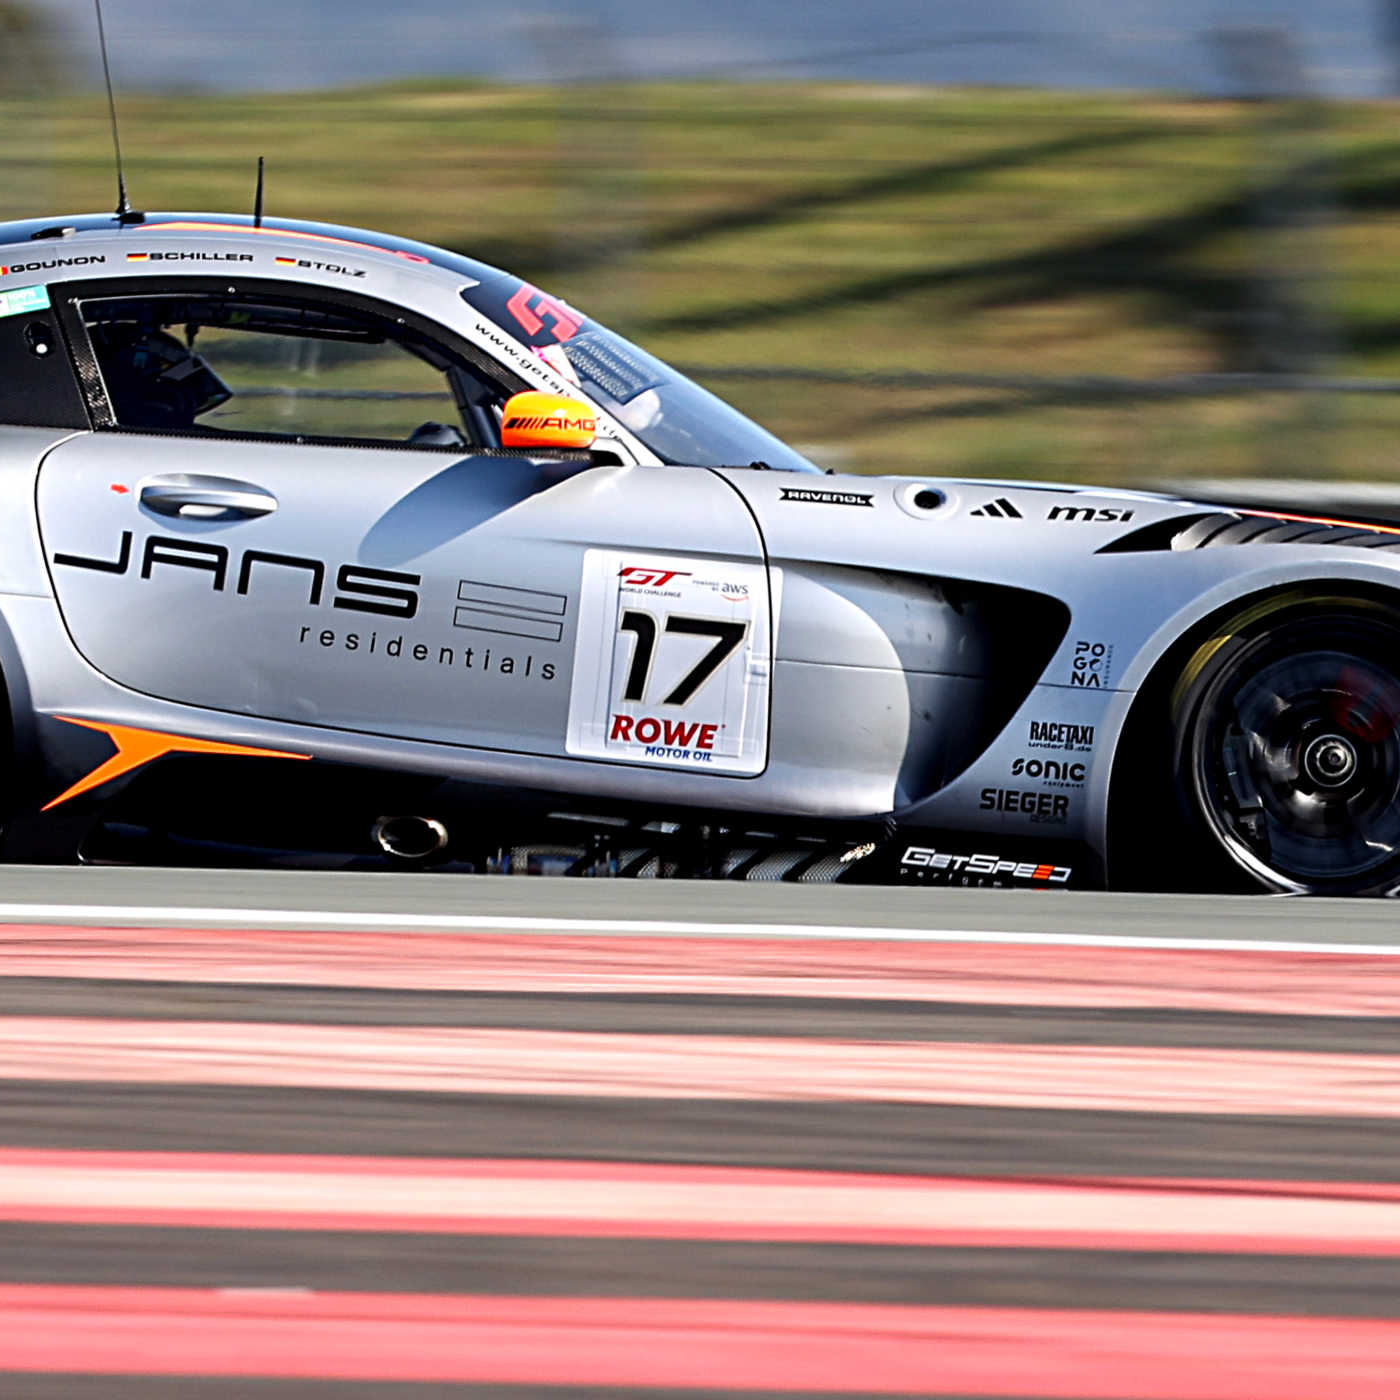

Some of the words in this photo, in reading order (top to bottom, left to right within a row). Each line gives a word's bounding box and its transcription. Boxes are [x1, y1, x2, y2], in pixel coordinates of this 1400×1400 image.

[10, 255, 106, 273] GOUNON
[149, 252, 253, 262] SCHILLER
[298, 259, 367, 278] STOLZ
[788, 491, 866, 505] RAVENOL
[617, 567, 693, 587] GT
[644, 589, 682, 599] CHALLENGE
[721, 583, 749, 595] aws
[300, 626, 556, 680] residentials
[618, 608, 749, 708] 17
[610, 714, 719, 749] ROWE
[645, 745, 690, 760] MOTOR
[693, 750, 713, 762] OIL
[980, 788, 1070, 817] SIEGER
